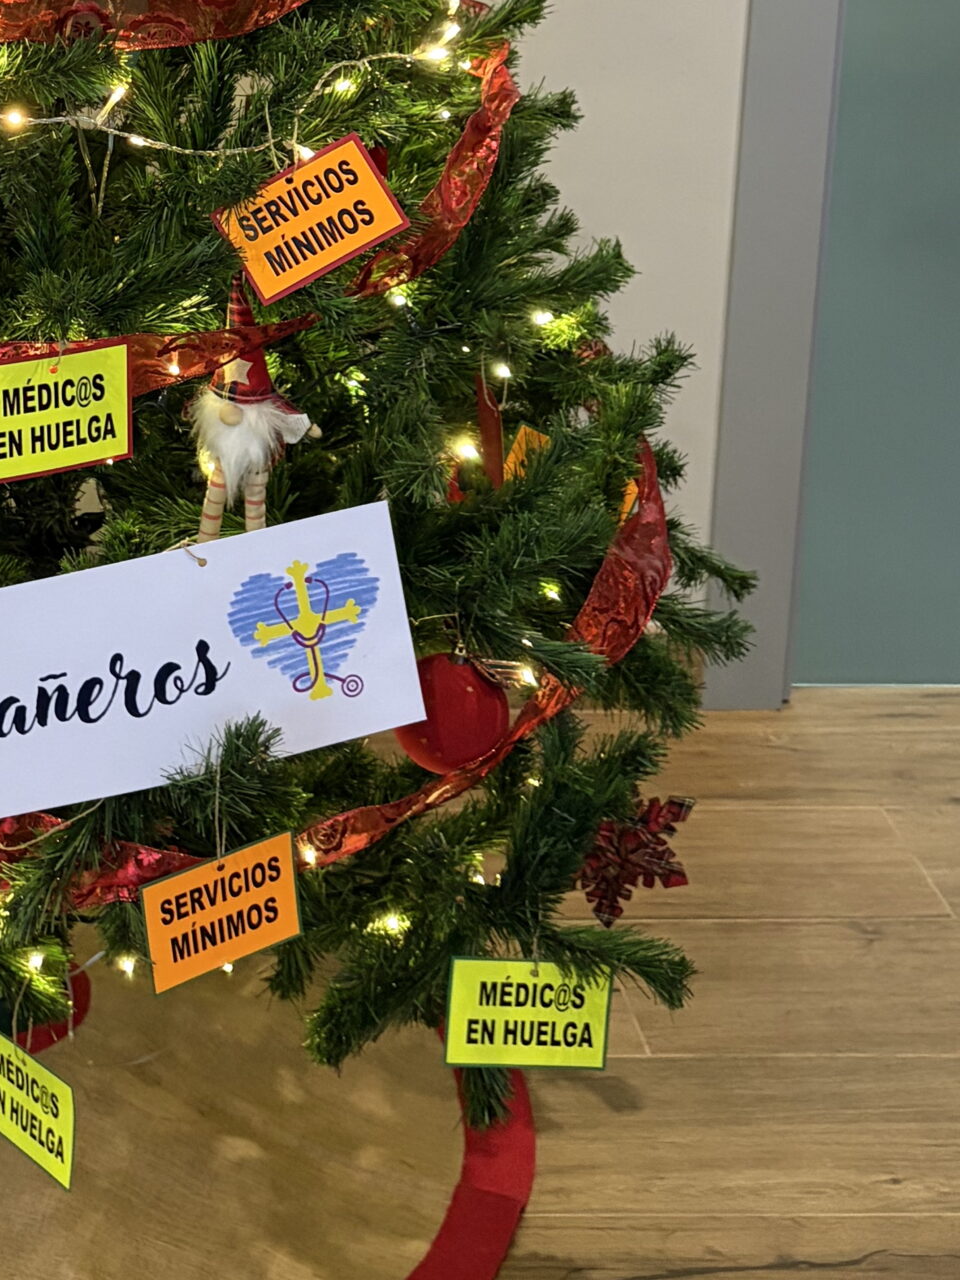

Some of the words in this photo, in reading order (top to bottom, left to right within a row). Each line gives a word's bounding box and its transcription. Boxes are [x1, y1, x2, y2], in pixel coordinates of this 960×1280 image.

[239, 159, 360, 242] SERVICIOS
[263, 199, 375, 277] MÍNIMOS
[1, 373, 106, 417] MÉDIC@S
[30, 412, 117, 455] HUELGA
[159, 856, 282, 925] SERVICIOS
[170, 896, 279, 963] MÍNIMOS
[478, 975, 586, 1012] MÉDIC@S
[465, 1019, 496, 1045] EN
[502, 1020, 594, 1048] HUELGA
[9, 1096, 66, 1164] HUELGA
